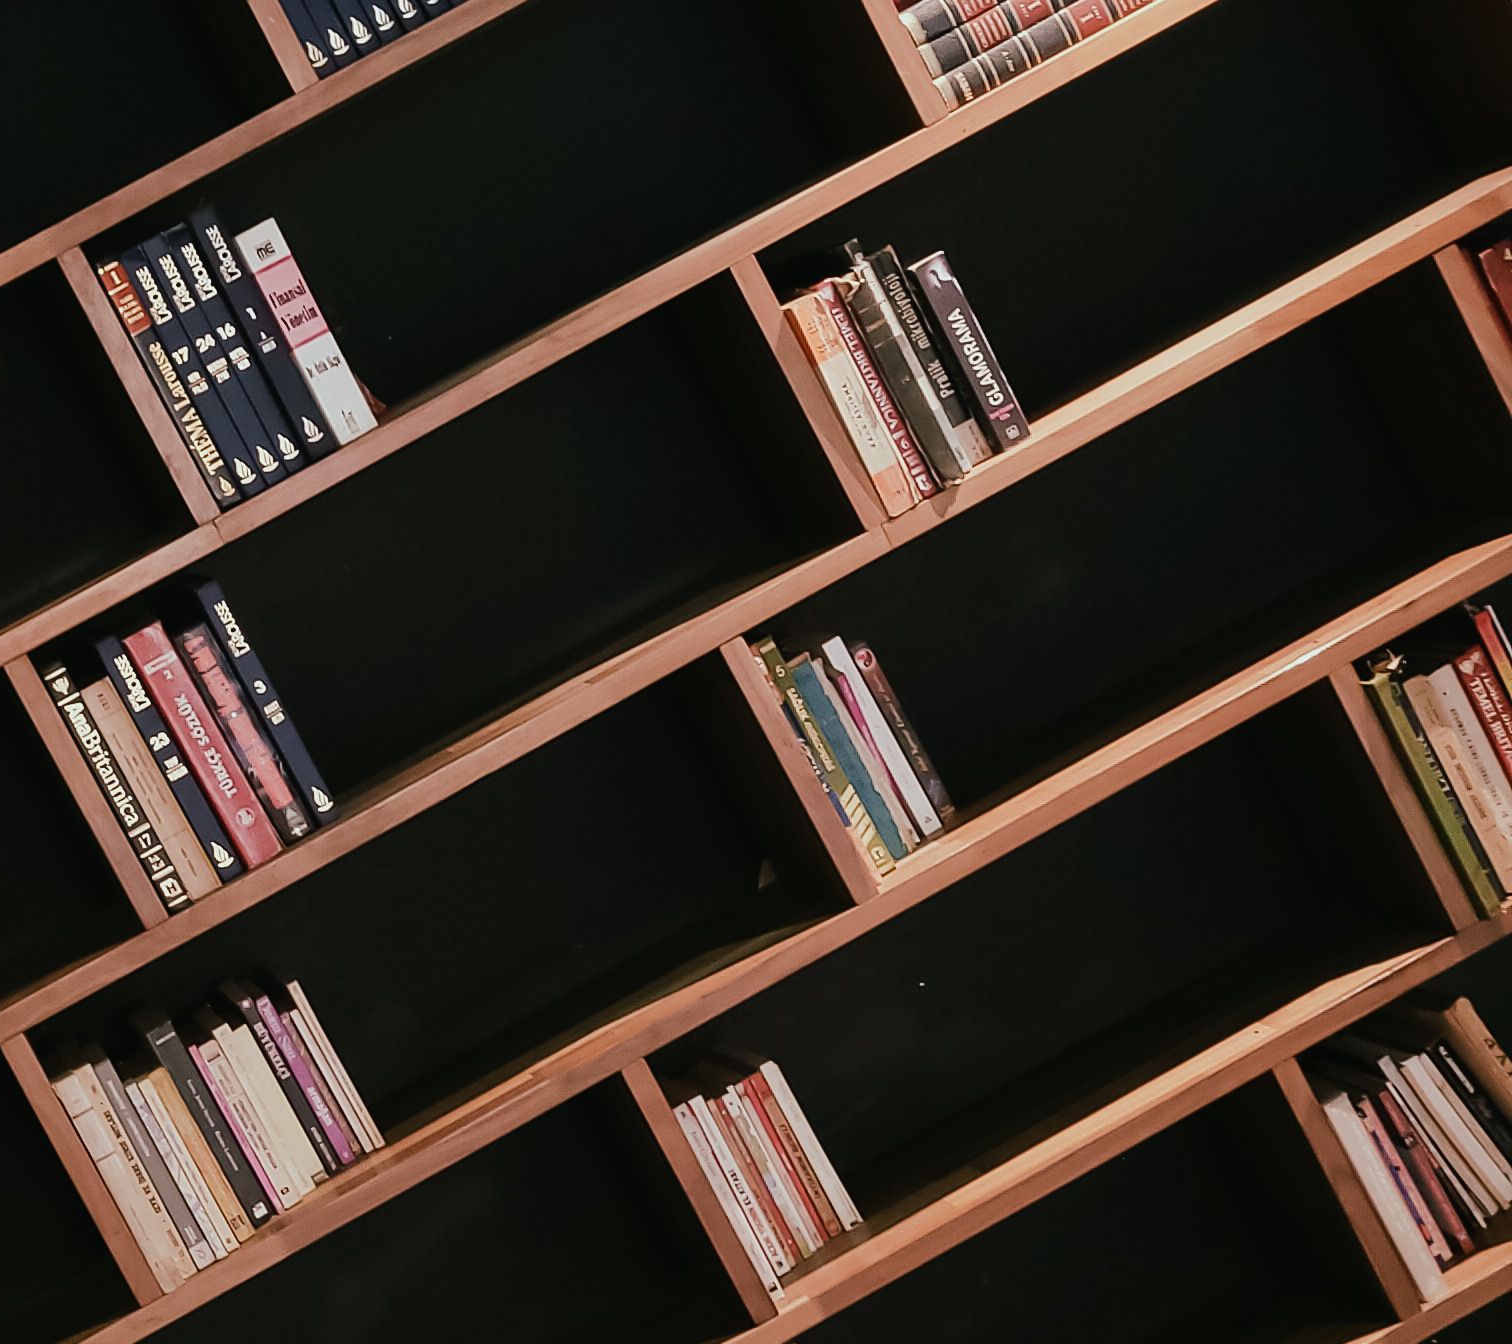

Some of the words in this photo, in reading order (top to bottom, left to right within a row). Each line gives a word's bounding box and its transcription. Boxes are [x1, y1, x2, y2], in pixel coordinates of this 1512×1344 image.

[157, 252, 197, 313] LAROUSSE
[179, 241, 219, 302] LAROUSSE
[203, 223, 243, 284] LAROUSSE
[134, 264, 174, 326] LAROUSSE
[244, 305, 258, 322] 1
[170, 344, 193, 366] 17
[193, 332, 218, 354] 24
[215, 320, 237, 342] 16
[944, 305, 1005, 408] GLAMORAMA
[145, 339, 193, 411] Larousse
[175, 406, 226, 477] THÉMA
[213, 599, 251, 658] LAROUSSE
[113, 652, 152, 713] LAROUSSE
[251, 677, 269, 696] 3
[147, 729, 172, 753] 23
[172, 692, 211, 747] SÖZLÜK
[63, 698, 144, 828] AnaBritannica
[200, 745, 239, 800] TÜRKÇE
